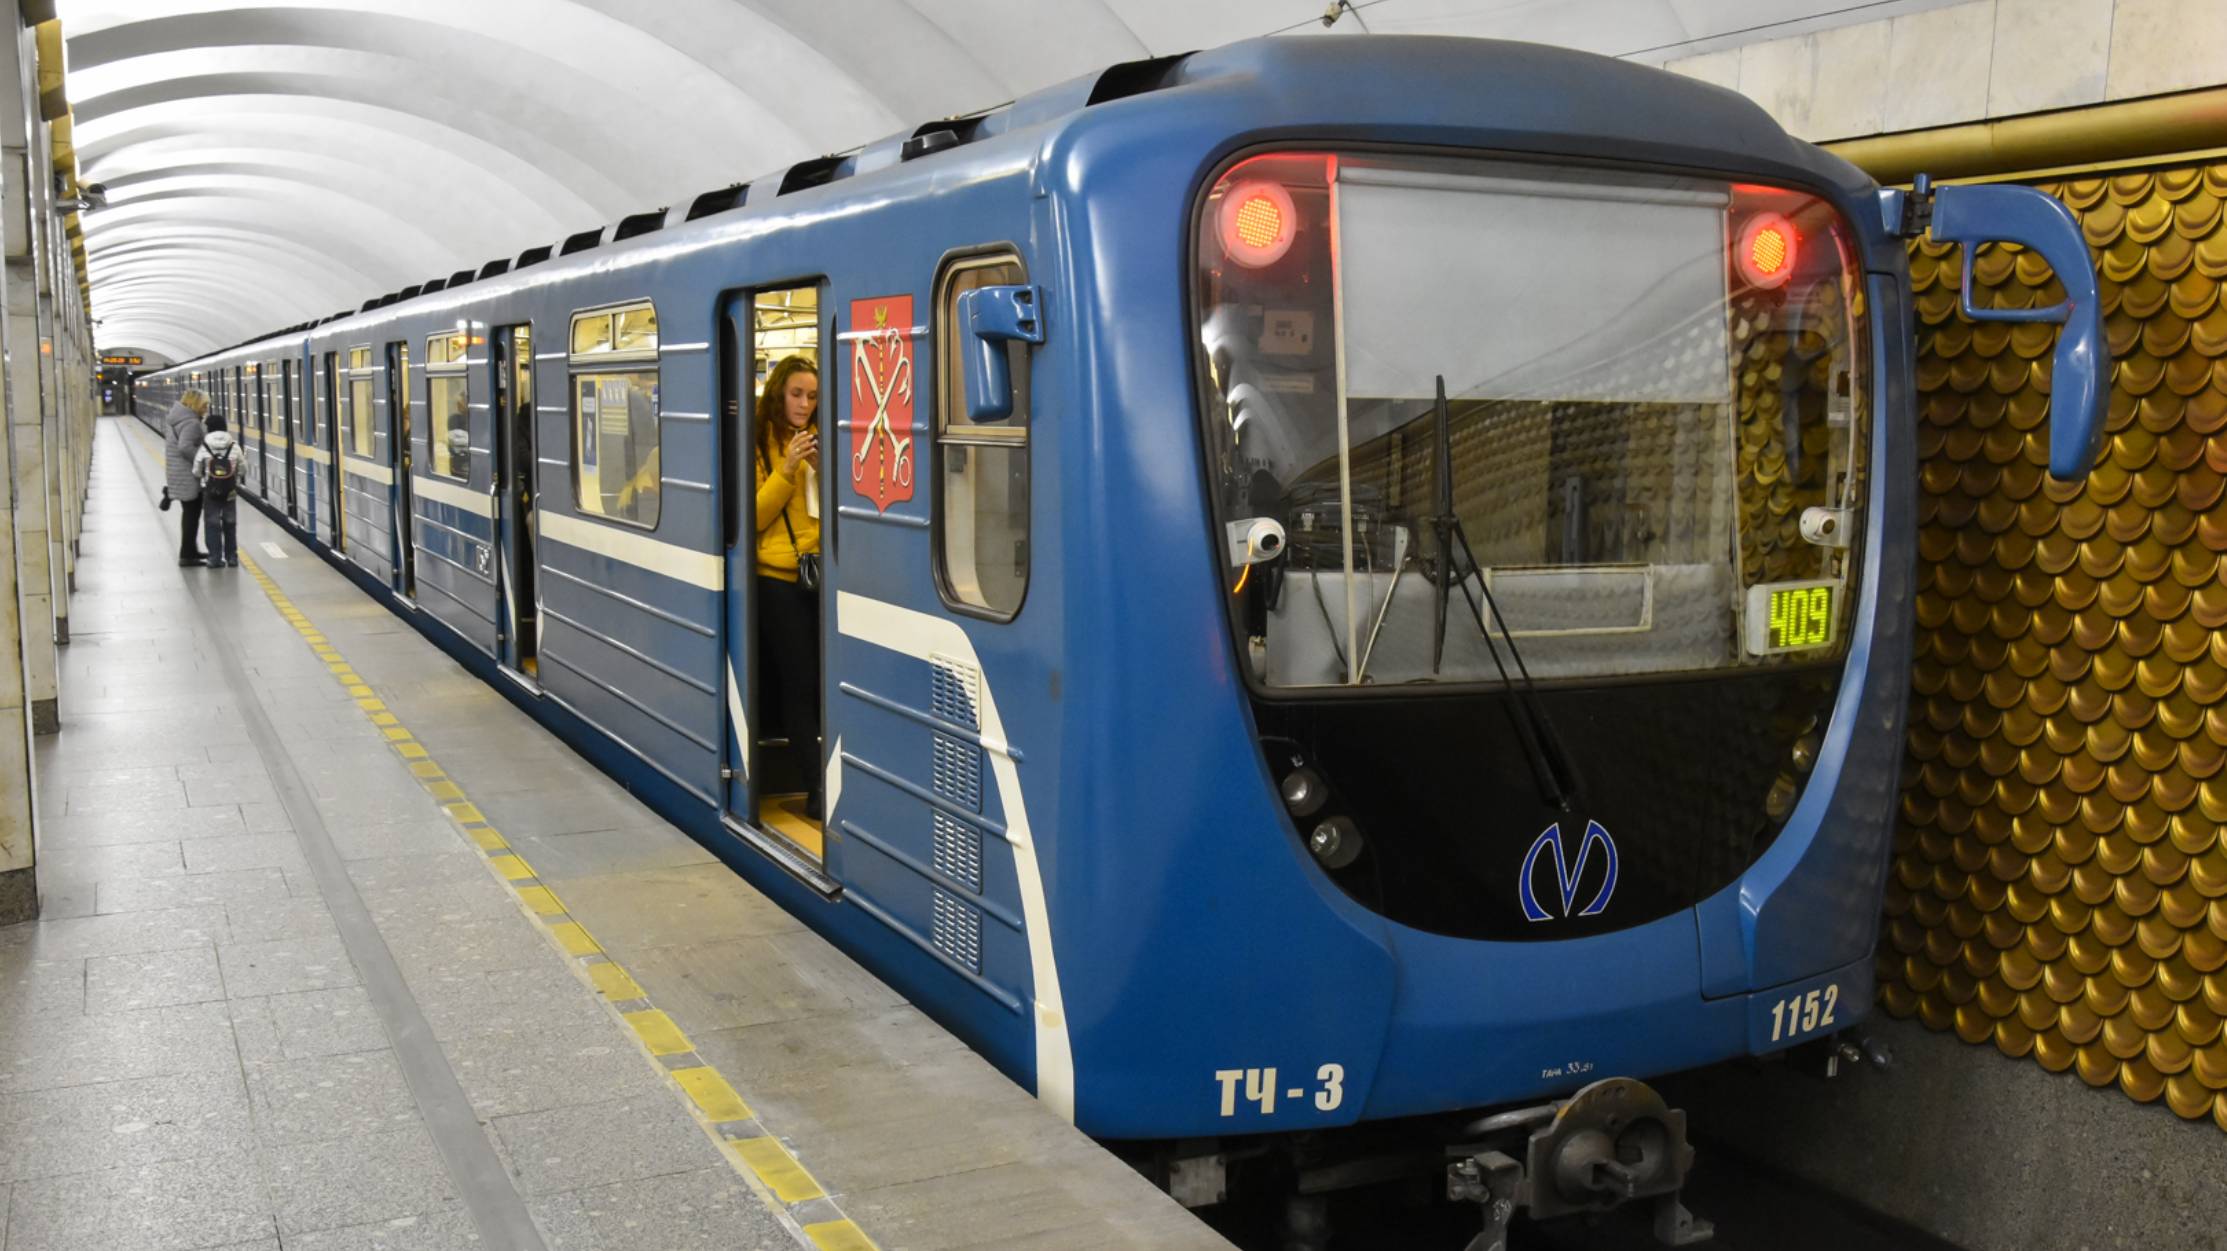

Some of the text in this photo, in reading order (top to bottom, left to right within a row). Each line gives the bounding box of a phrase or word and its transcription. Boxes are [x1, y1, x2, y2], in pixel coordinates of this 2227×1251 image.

[1769, 588, 1828, 647] 409
[1771, 984, 1839, 1042] 1152
[1215, 1066, 1278, 1117] ТЧ
[1314, 1062, 1345, 1111] 3
